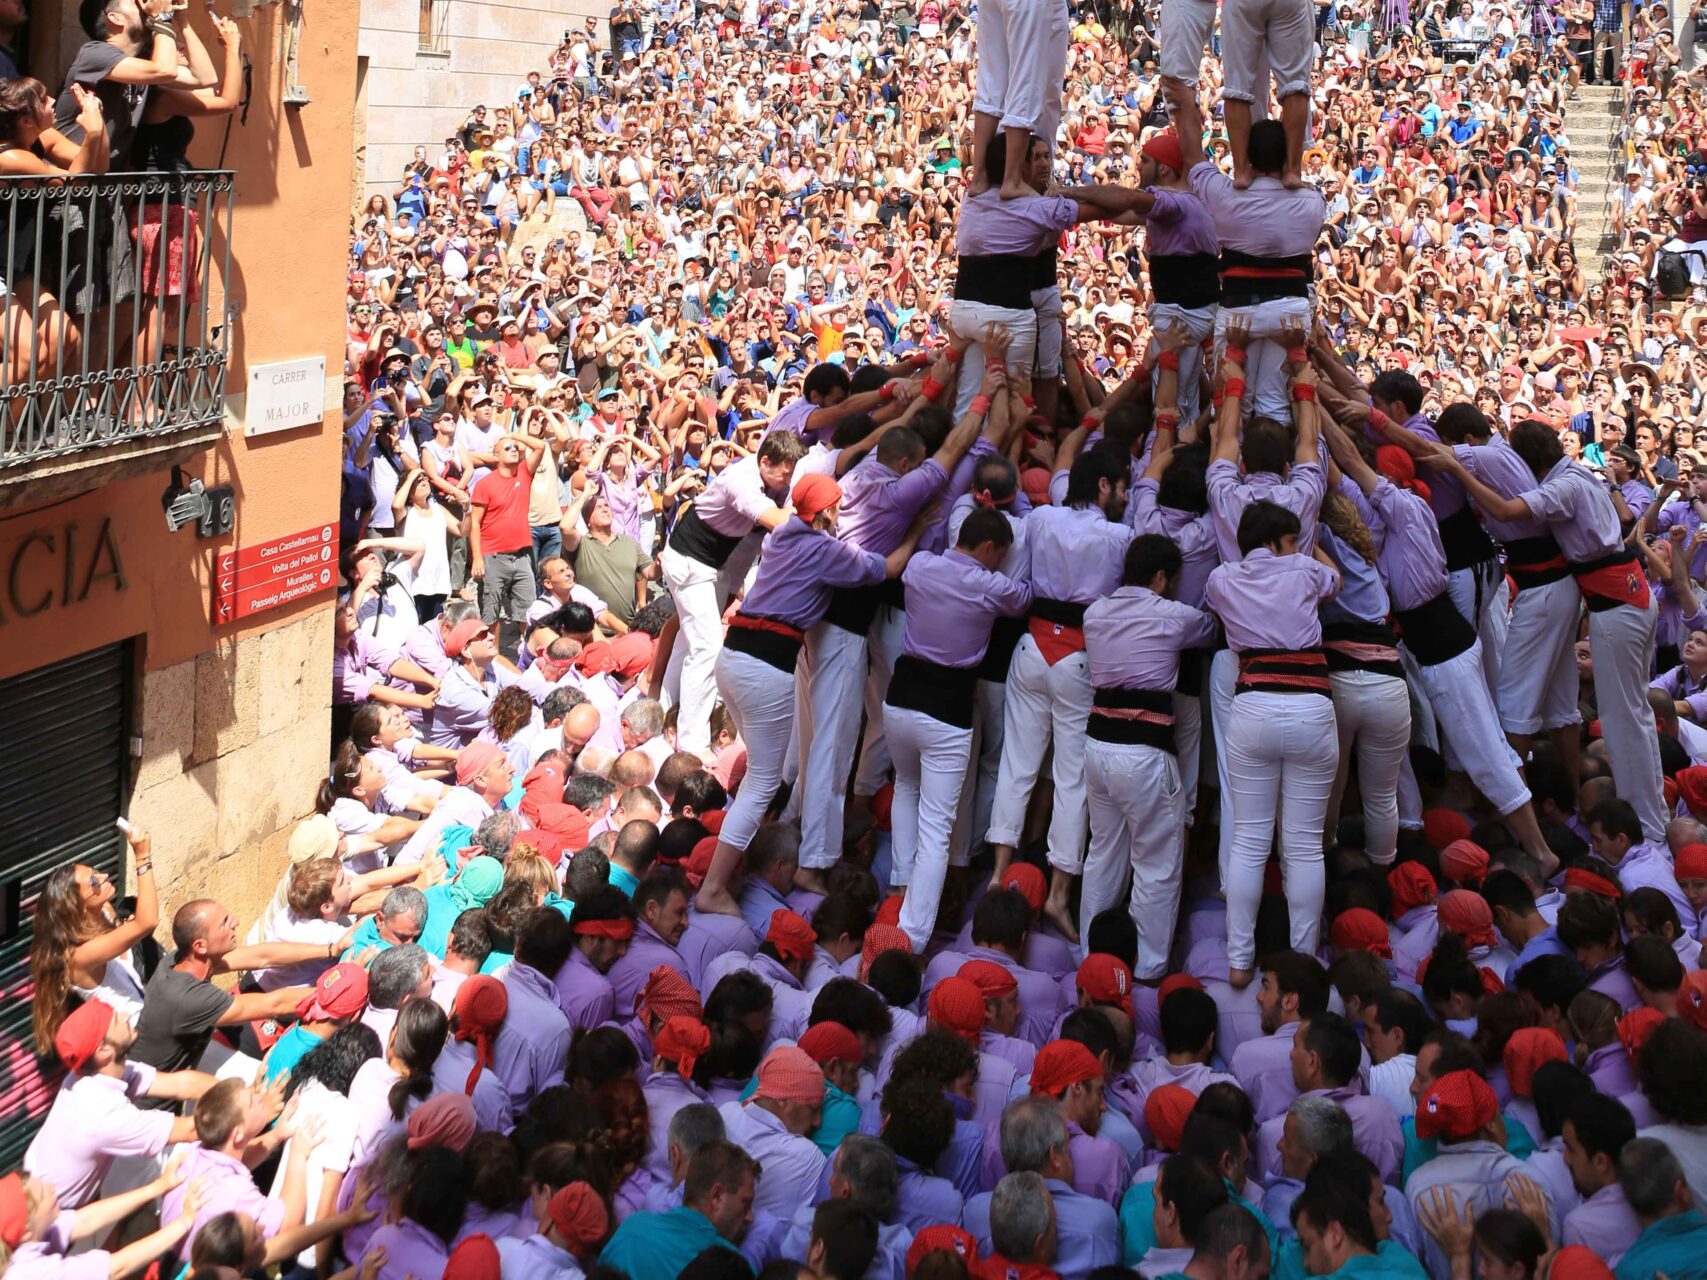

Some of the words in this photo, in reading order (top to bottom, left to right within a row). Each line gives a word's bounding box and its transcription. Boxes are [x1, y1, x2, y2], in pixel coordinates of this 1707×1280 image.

[272, 370, 307, 385] CARRER
[264, 402, 310, 422] MAJOR
[260, 547, 278, 558] Casa
[279, 534, 319, 552] Castellarnau
[0, 517, 129, 624] CIA
[271, 562, 289, 574] Volta
[289, 558, 300, 569] del
[301, 552, 319, 565] Pallol
[286, 572, 314, 587] Muralles
[251, 595, 278, 610] Passeig
